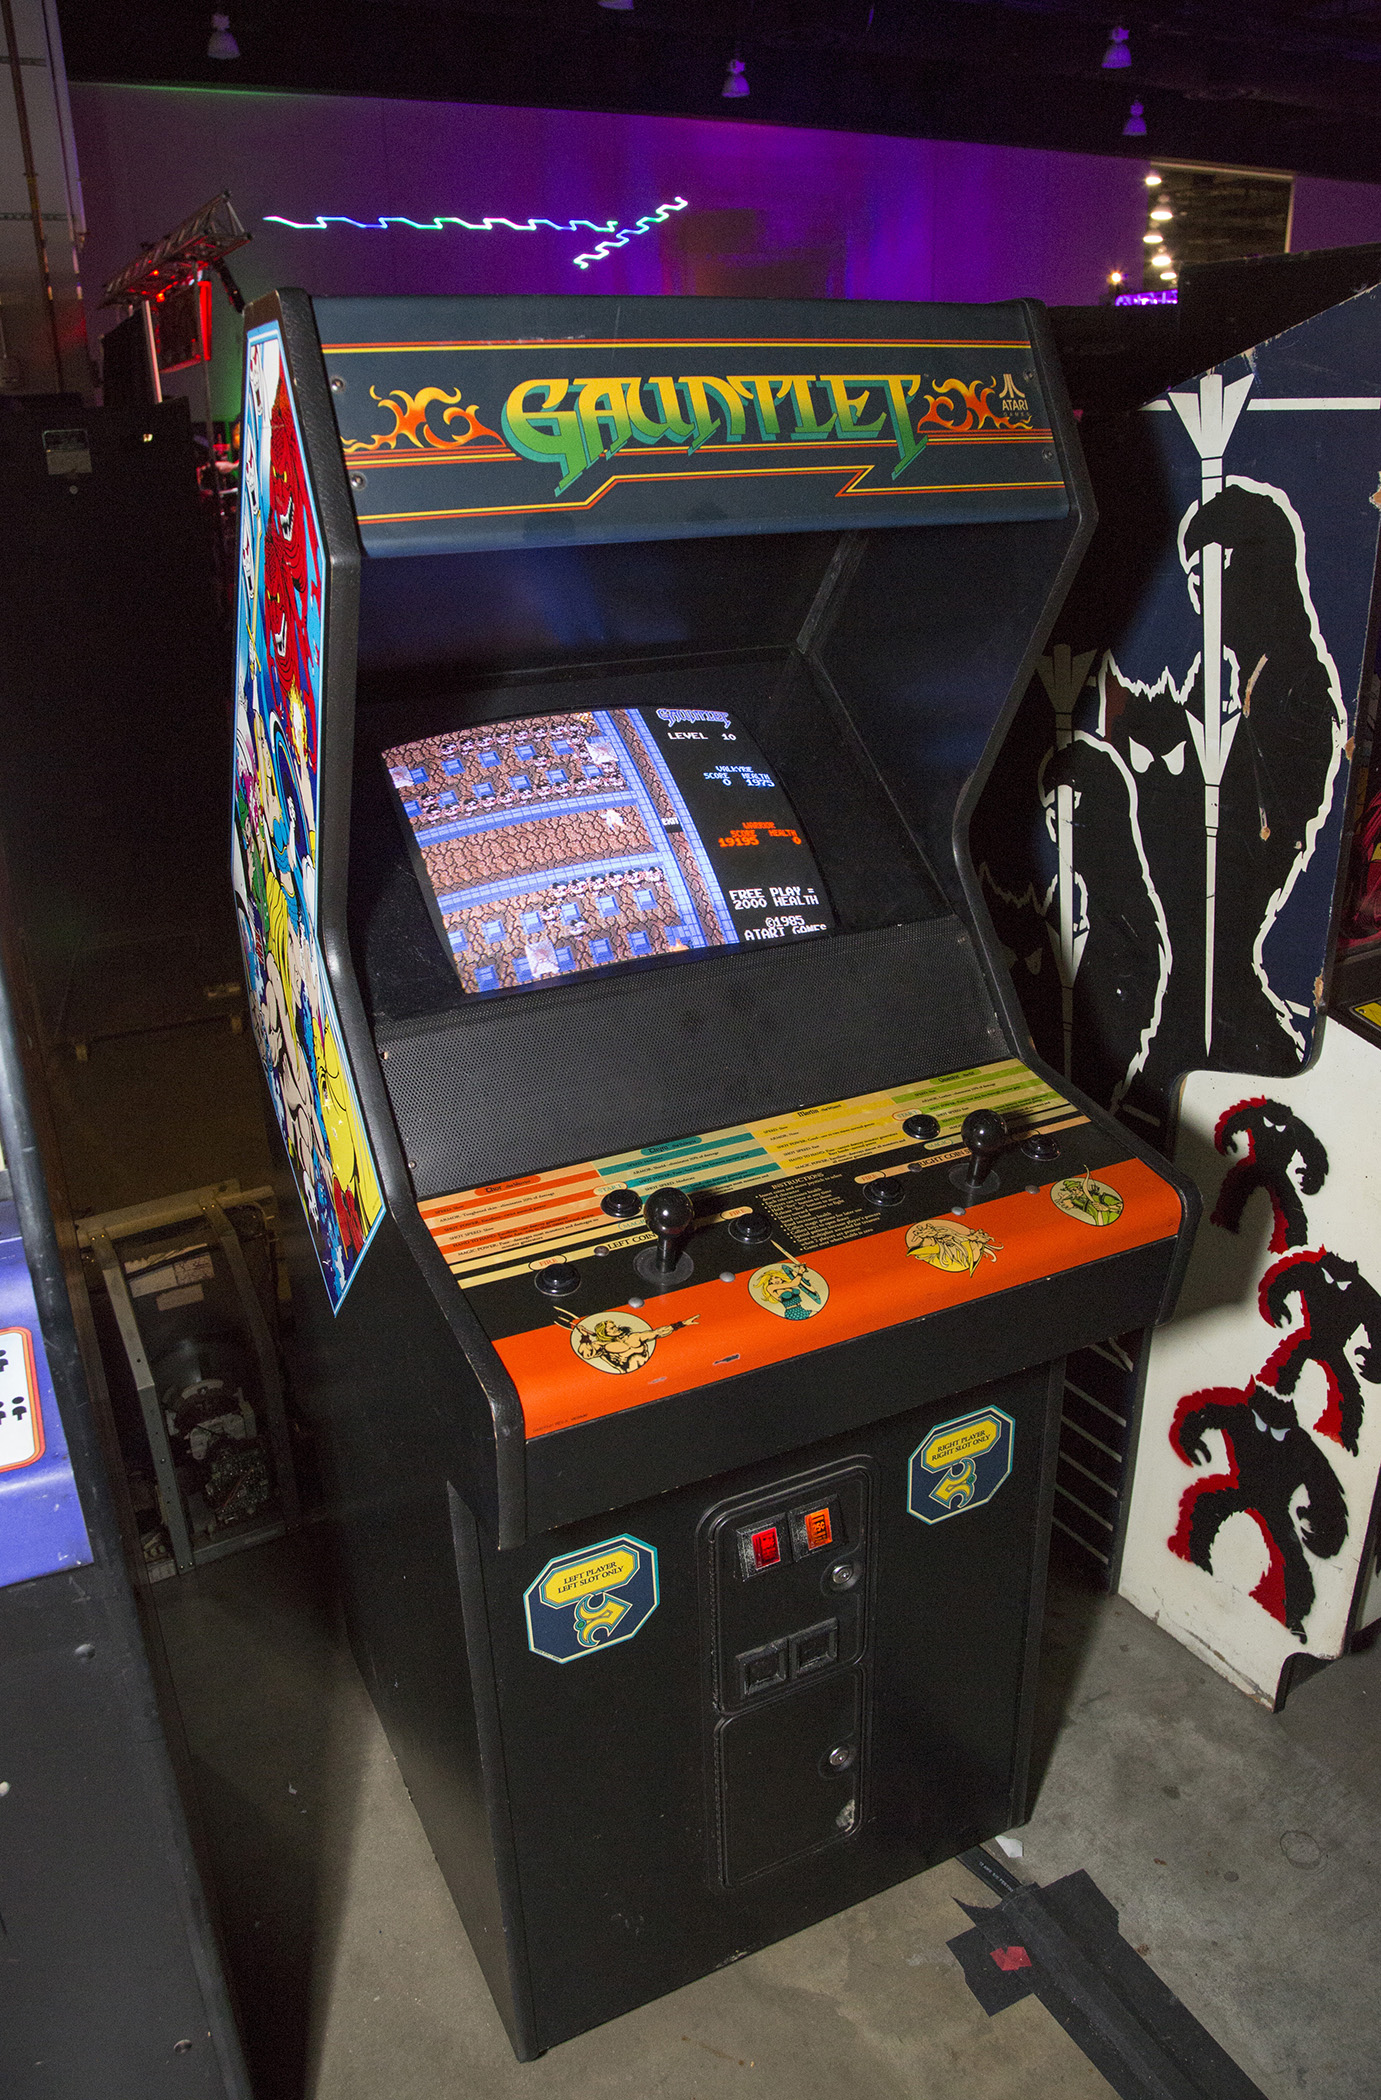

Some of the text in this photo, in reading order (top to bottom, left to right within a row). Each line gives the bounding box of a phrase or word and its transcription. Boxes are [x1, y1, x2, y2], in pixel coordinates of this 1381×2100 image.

[1002, 399, 1029, 411] ATARI
[501, 375, 929, 497] GAUNTLET
[668, 732, 736, 741] LEVEL 10
[746, 779, 775, 787] 1975
[661, 817, 679, 825] EXIT
[730, 829, 797, 838] SCORE HEALTH
[718, 837, 801, 848] 19195 0
[729, 888, 764, 901] FREE
[769, 886, 801, 897] PLAY
[733, 895, 819, 910] 2000 HEALTH
[765, 916, 805, 929] ©1985
[897, 1110, 917, 1118] START
[928, 1140, 950, 1148] MAGIC
[919, 1156, 944, 1166] RIGHT
[945, 1151, 964, 1159] COIN
[772, 1172, 824, 1189] INSTRUCTIONS
[598, 1184, 621, 1192] START
[608, 1232, 657, 1249] LEFT COIN
[539, 1258, 558, 1266] FIRE
[932, 1434, 990, 1461] RIGHT SLOT ONLY
[938, 1430, 985, 1452] RIGHT PLAYER
[558, 1566, 624, 1593] LEFT SLOT ONLY
[564, 1562, 616, 1584] LEFT PLAYER
